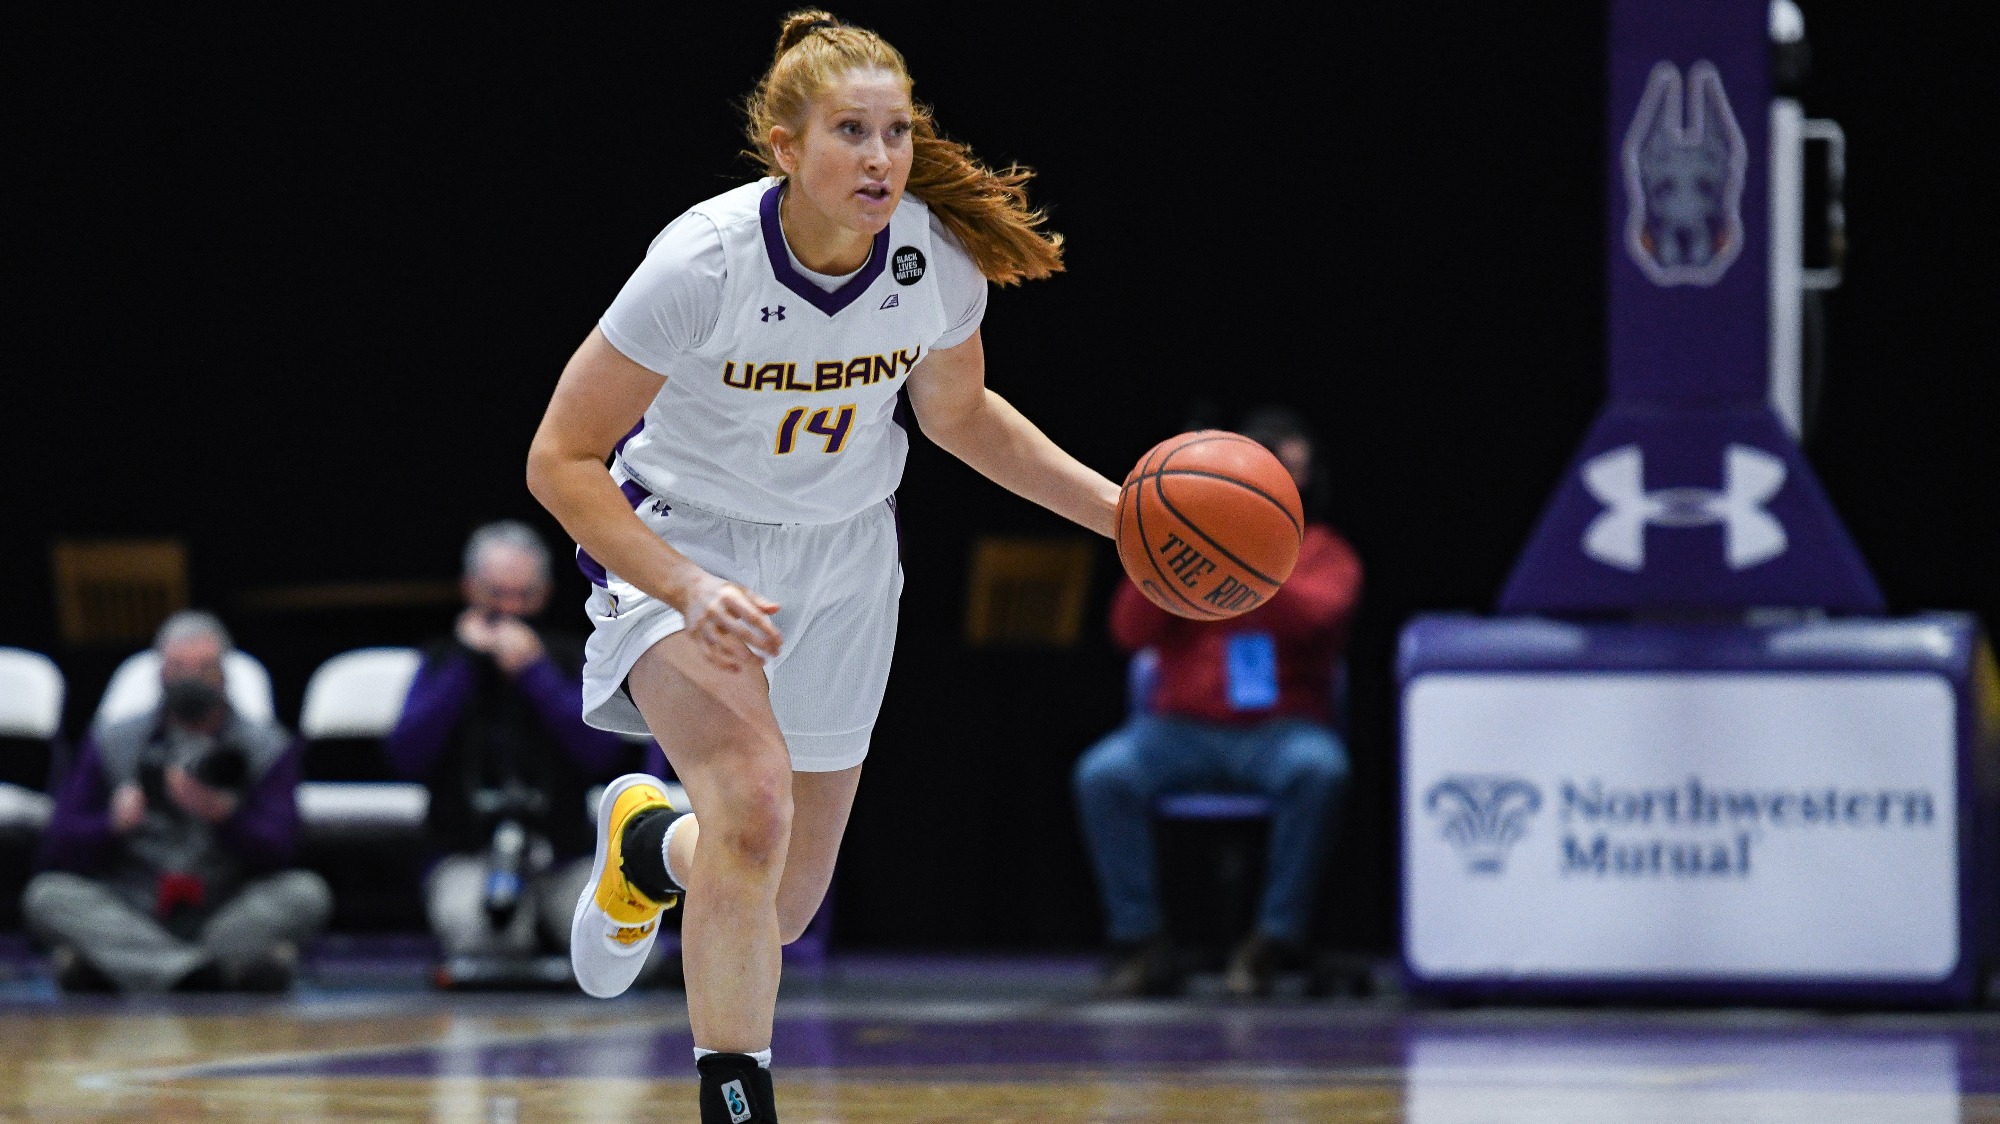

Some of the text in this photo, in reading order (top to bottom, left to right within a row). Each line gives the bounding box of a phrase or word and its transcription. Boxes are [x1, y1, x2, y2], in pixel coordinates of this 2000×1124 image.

[897, 253, 917, 264] BLACK
[897, 268, 922, 280] MATTER
[899, 261, 917, 271] LIVES
[722, 344, 921, 392] UALBANY
[774, 403, 857, 456] 14
[1160, 532, 1217, 588] THE
[1559, 774, 1934, 824] Northwestern
[1560, 830, 1751, 876] Mutual
